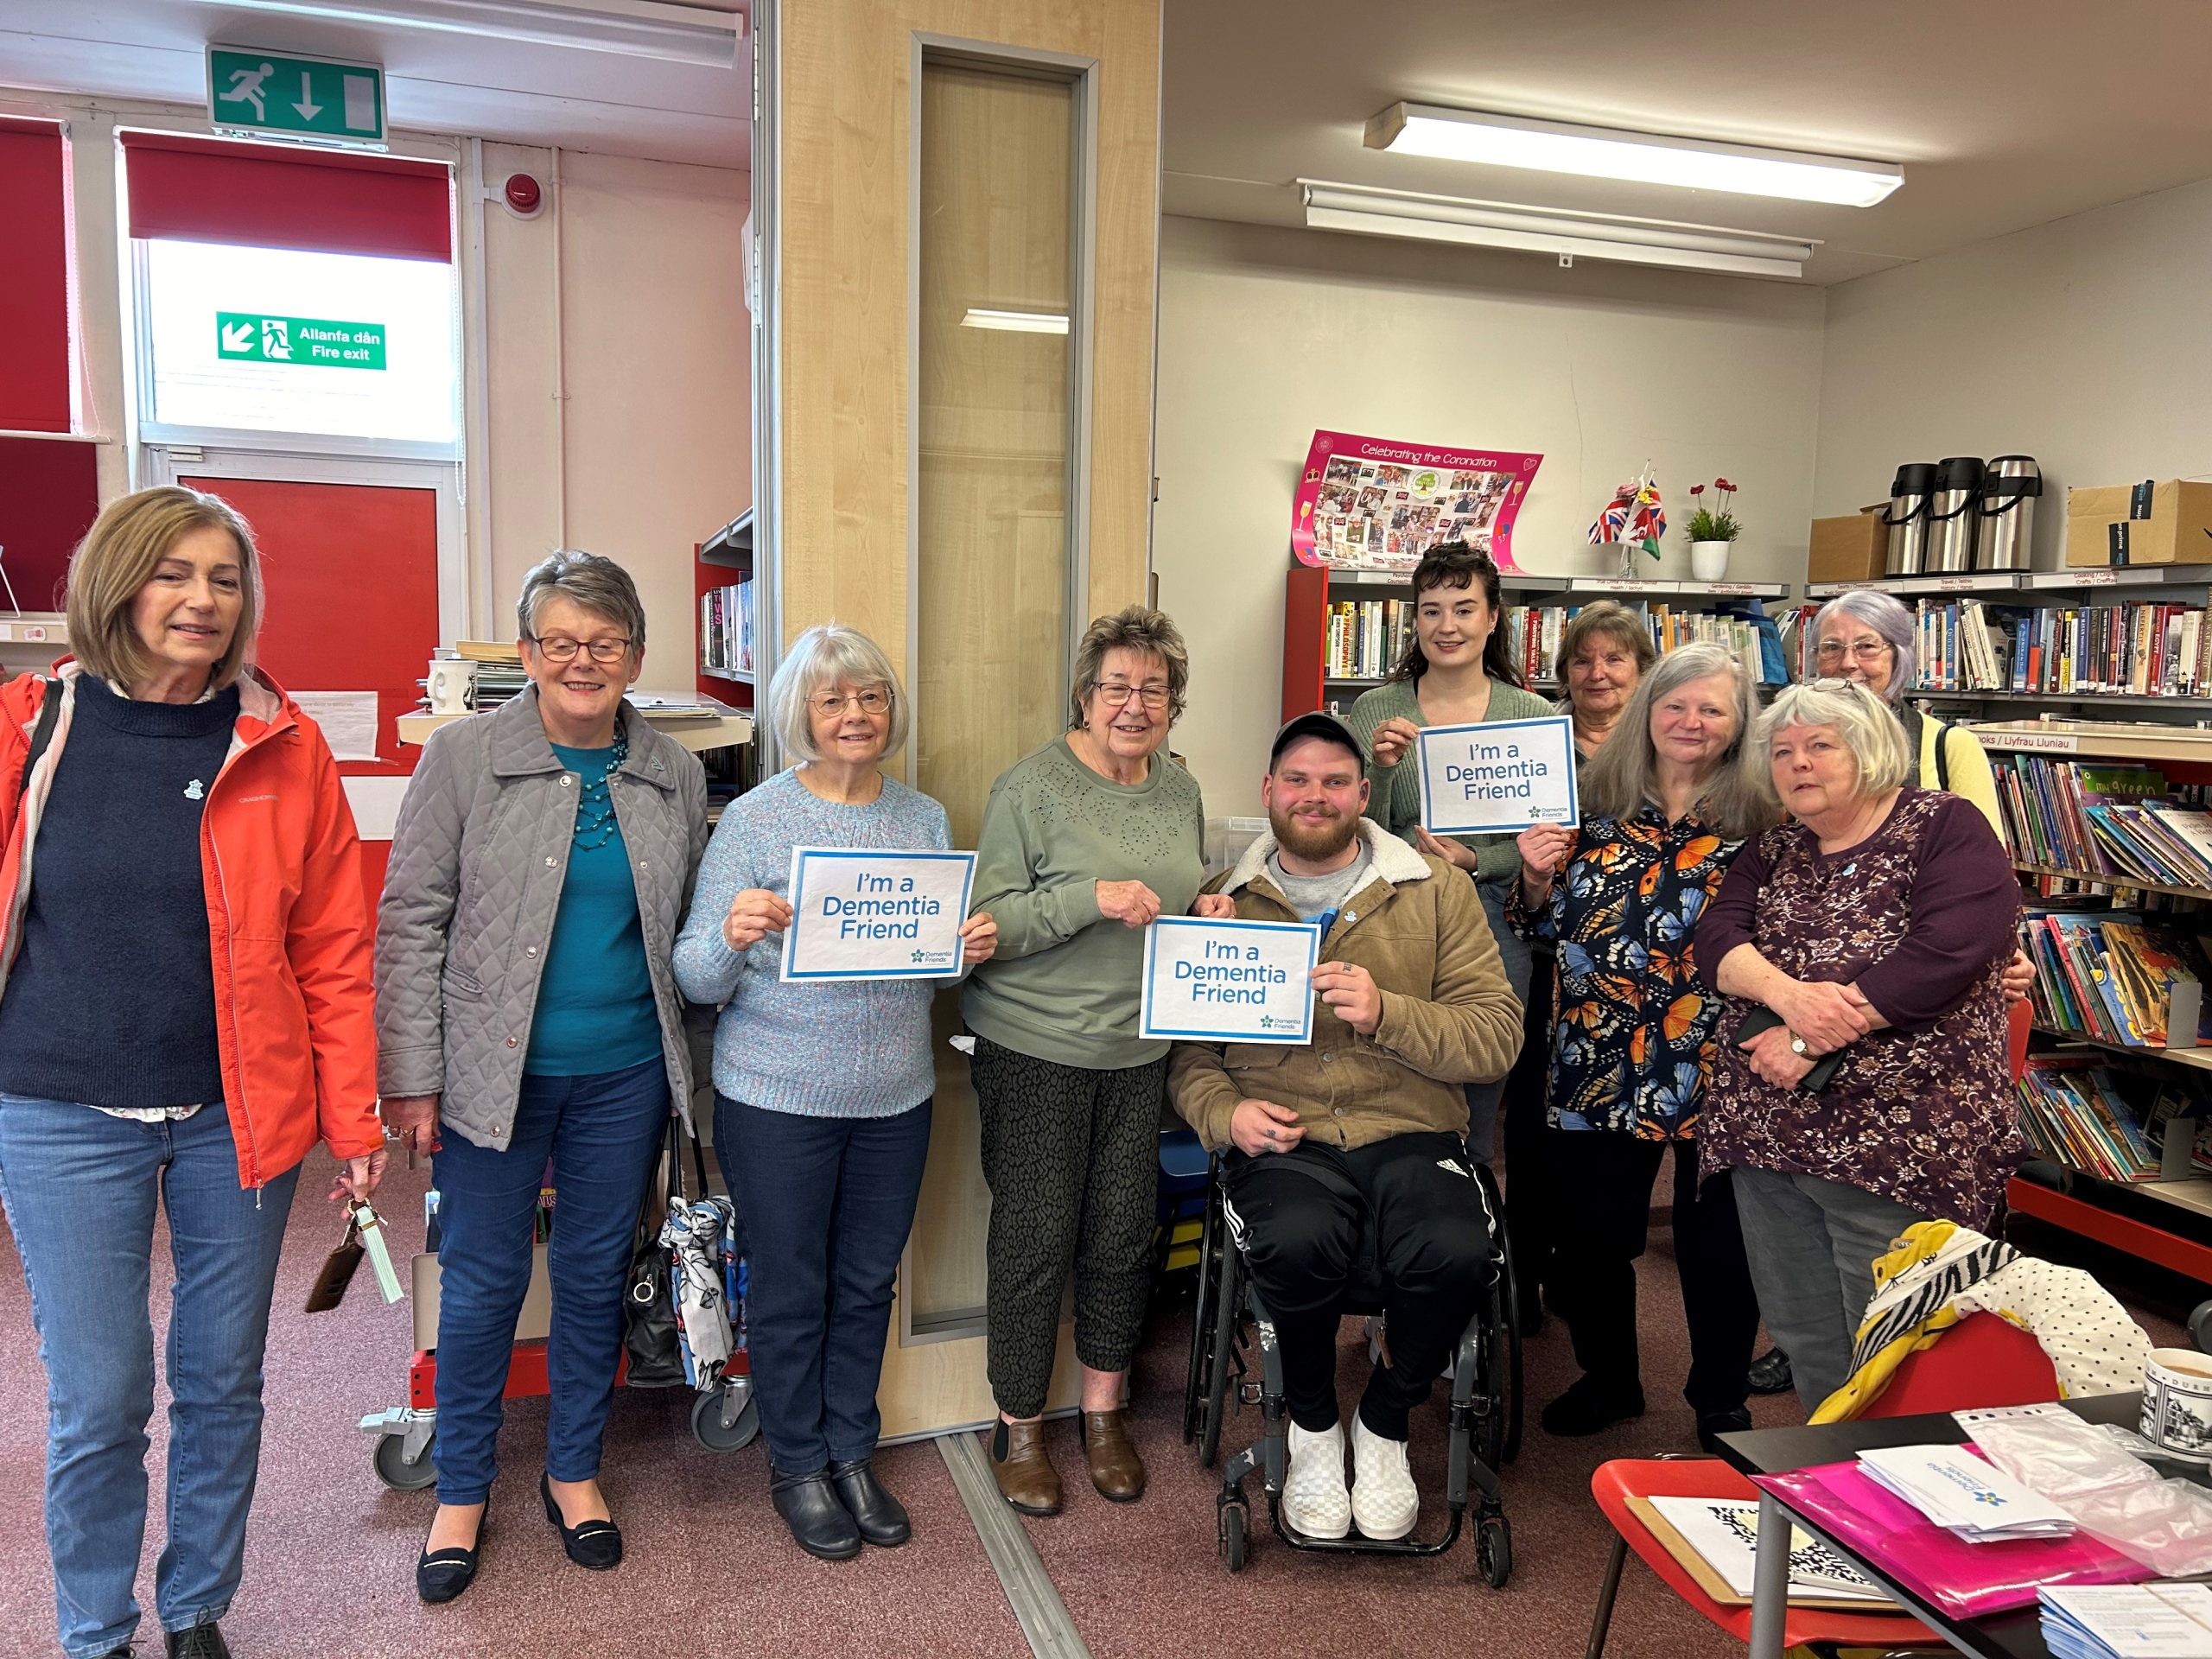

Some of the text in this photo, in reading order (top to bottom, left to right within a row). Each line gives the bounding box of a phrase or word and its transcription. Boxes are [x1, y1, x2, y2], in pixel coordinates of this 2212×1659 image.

[299, 327, 380, 345] Allanfa dân
[312, 346, 370, 360] Fire exit
[1361, 442, 1497, 467] Celebrating the Coronation
[1342, 623, 1351, 664] PHILOSOPHY
[1469, 744, 1519, 760] I'm a
[2005, 736, 2033, 747] Llyfrau
[2037, 737, 2069, 748] Lluniau
[1446, 760, 1548, 782] Dementia
[1465, 779, 1531, 800] Friend
[2112, 781, 2156, 795] green
[856, 873, 914, 893] I'm a
[823, 895, 940, 916] Dementia
[840, 918, 918, 940] Friend
[1205, 940, 1259, 961] I'm a
[1175, 960, 1286, 984] Dementia
[1192, 983, 1266, 1005] Friend
[2172, 1379, 2211, 1392] DURH
[1927, 1463, 1975, 1491] Dementia
